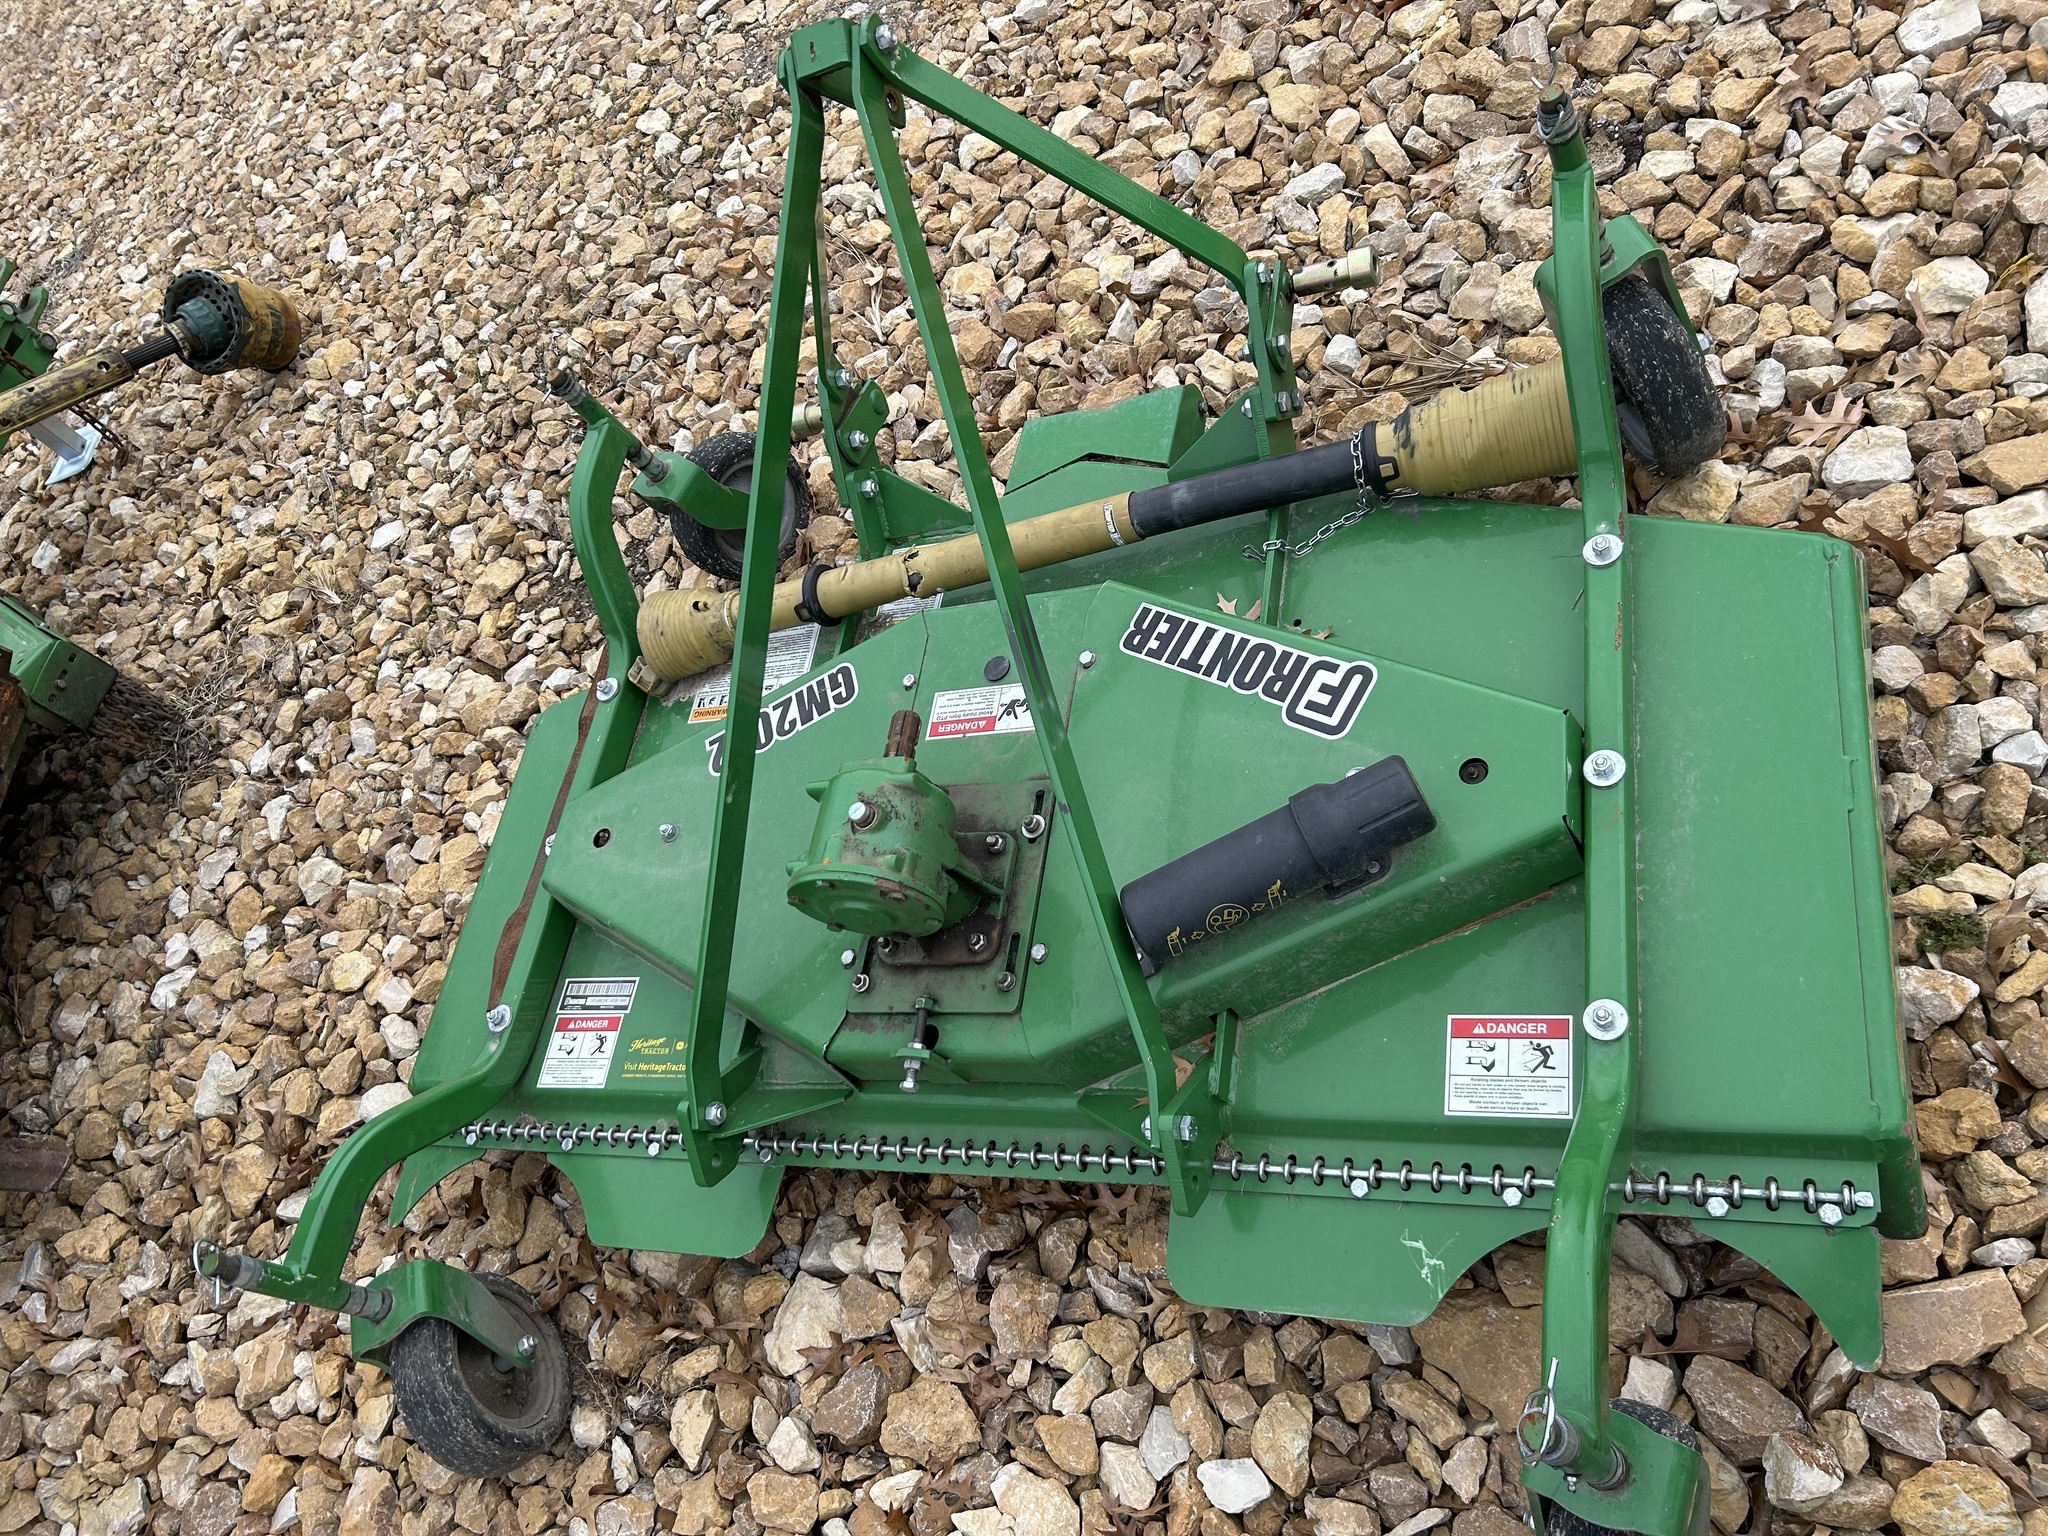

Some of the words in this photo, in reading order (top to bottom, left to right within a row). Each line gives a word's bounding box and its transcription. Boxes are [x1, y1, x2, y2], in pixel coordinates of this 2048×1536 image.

[1122, 606, 1374, 737] FRONTIER
[706, 664, 857, 776] GM202
[938, 721, 978, 732] DANGER
[574, 1020, 609, 1028] DANGER
[1487, 1023, 1547, 1034] DANGER
[628, 1037, 667, 1052] Heritage
[640, 1047, 670, 1055] TRACTOR
[623, 1062, 637, 1071] Visit
[637, 1062, 686, 1073] HeritageTracto
